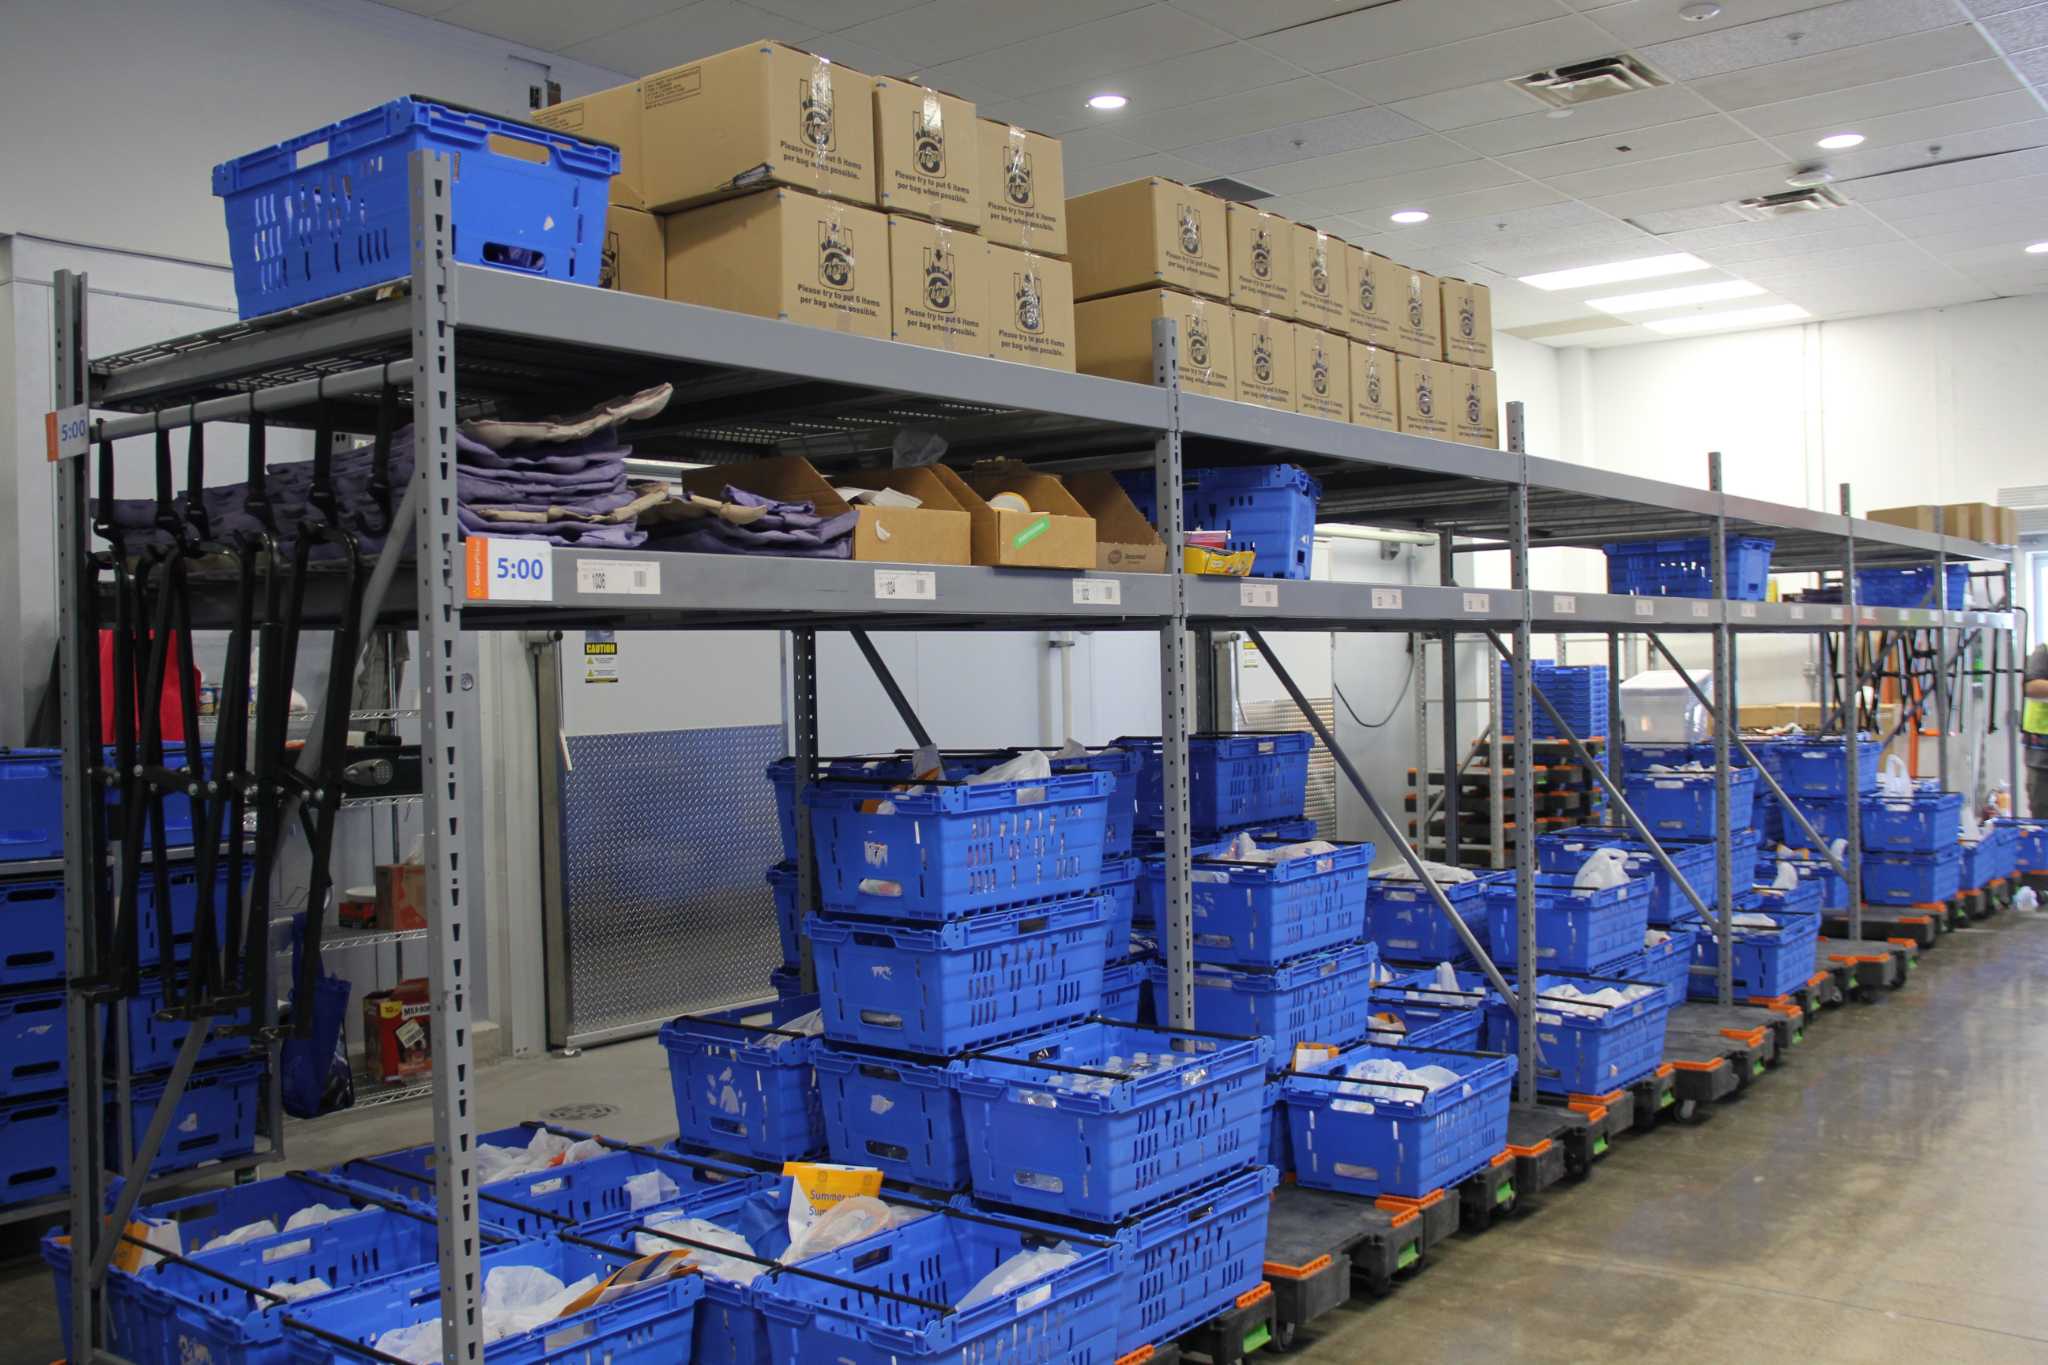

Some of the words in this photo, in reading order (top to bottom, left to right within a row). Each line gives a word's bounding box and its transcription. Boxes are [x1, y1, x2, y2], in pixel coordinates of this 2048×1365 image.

[798, 284, 820, 295] Please
[822, 290, 832, 299] try
[843, 294, 854, 302] put
[862, 297, 880, 307] items
[800, 296, 812, 304] per
[814, 298, 826, 309] bag
[828, 302, 846, 310] when
[62, 420, 86, 440] 5:00
[496, 558, 544, 580] 5:00
[586, 644, 616, 654] CAUTION
